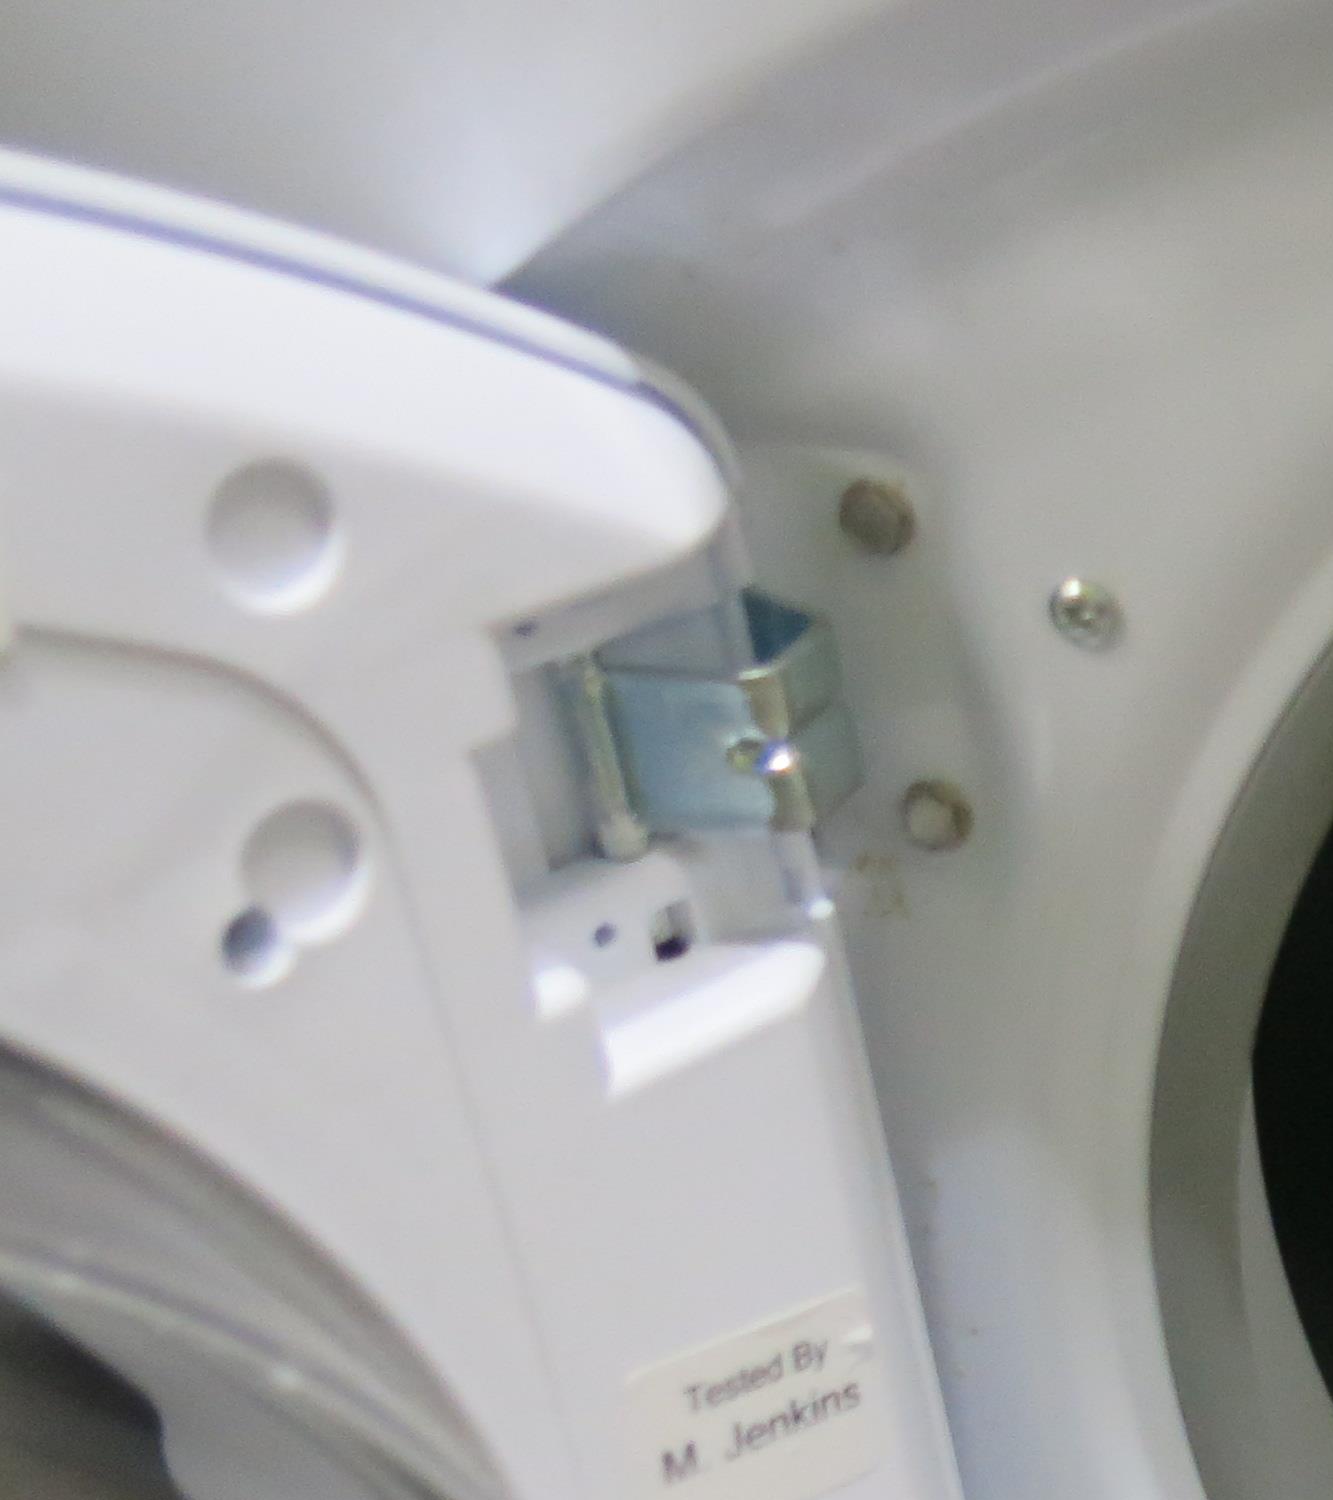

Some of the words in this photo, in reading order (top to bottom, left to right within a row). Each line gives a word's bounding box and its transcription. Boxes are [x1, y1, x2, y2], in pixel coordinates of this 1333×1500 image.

[683, 1352, 784, 1412] Tested
[792, 1338, 828, 1374] By
[724, 1382, 862, 1462] Jenkins
